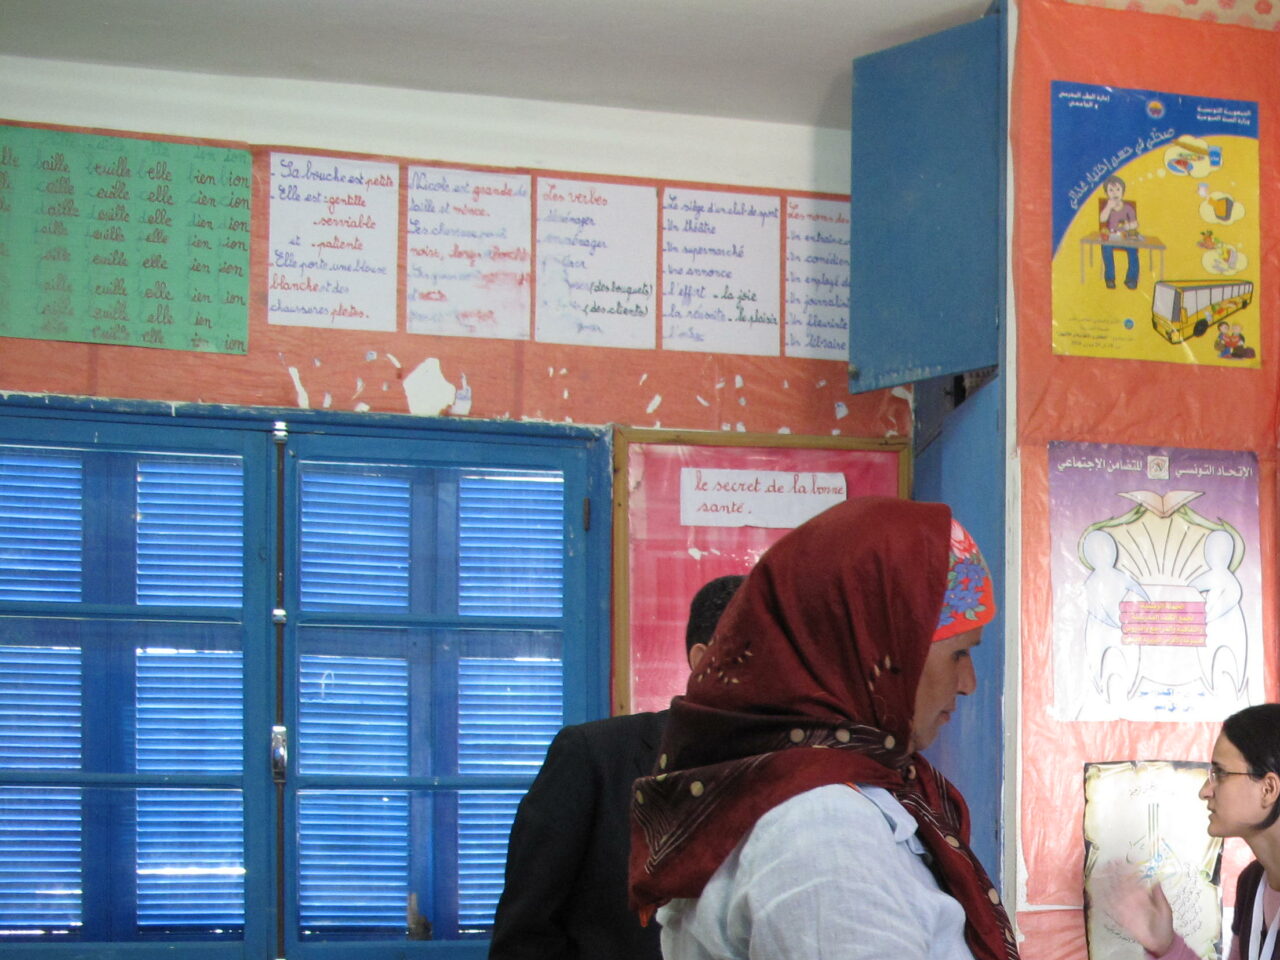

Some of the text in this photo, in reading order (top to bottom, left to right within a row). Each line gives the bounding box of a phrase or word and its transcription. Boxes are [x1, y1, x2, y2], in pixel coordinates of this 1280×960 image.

[568, 187, 608, 206] verbes
[694, 470, 845, 496] le secret de la bonne
